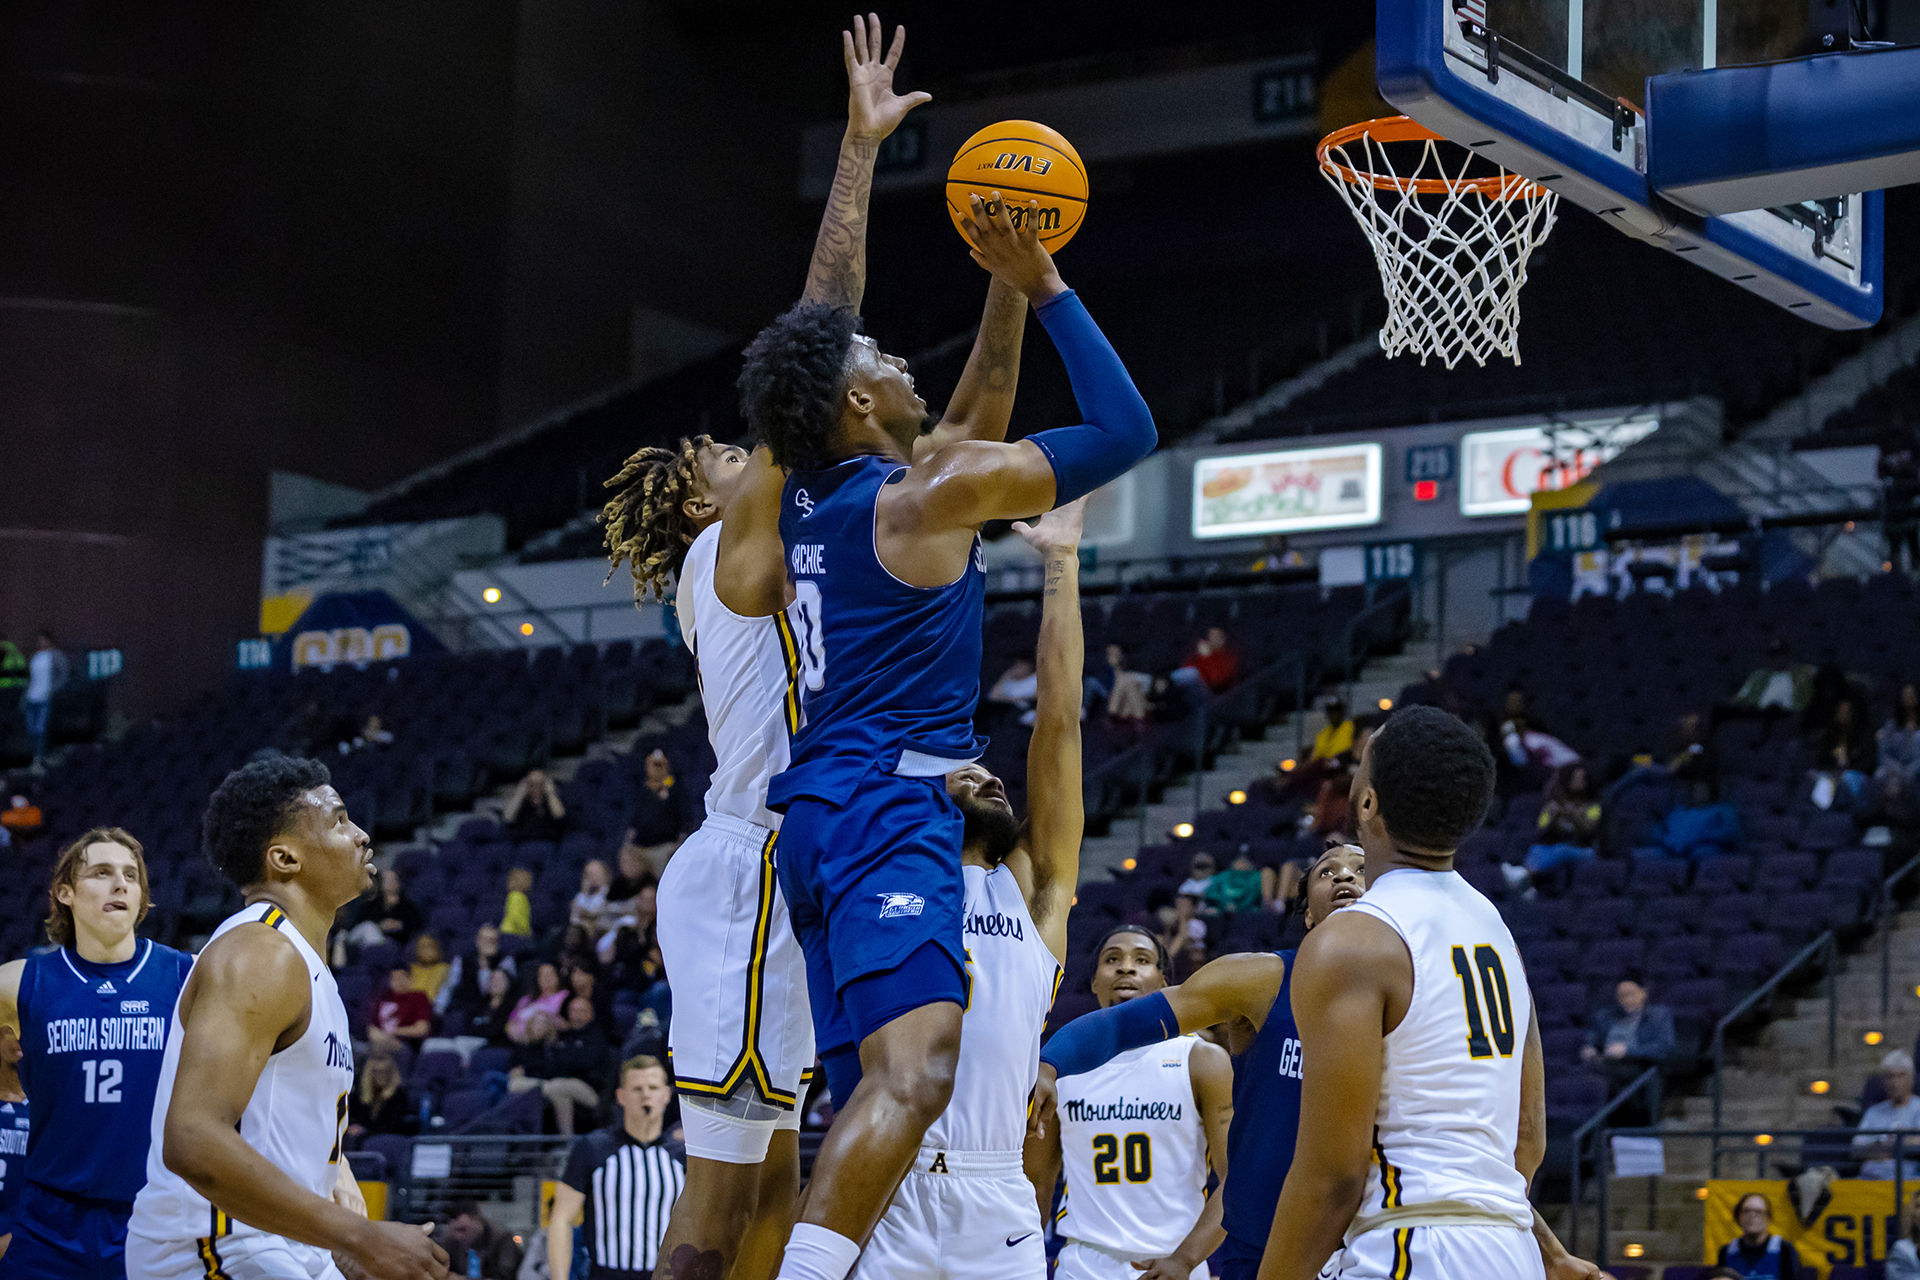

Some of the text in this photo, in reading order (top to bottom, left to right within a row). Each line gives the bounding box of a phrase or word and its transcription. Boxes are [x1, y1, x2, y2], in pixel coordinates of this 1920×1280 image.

[993, 153, 1053, 176] EVO
[1371, 543, 1414, 578] 115
[1450, 942, 1515, 1061] 10
[47, 1017, 165, 1055] GEORGIA SOUTHERN
[82, 1059, 123, 1103] 12
[1063, 1096, 1182, 1122] Mountaineers
[928, 1151, 949, 1174] A
[1092, 1132, 1153, 1185] 20
